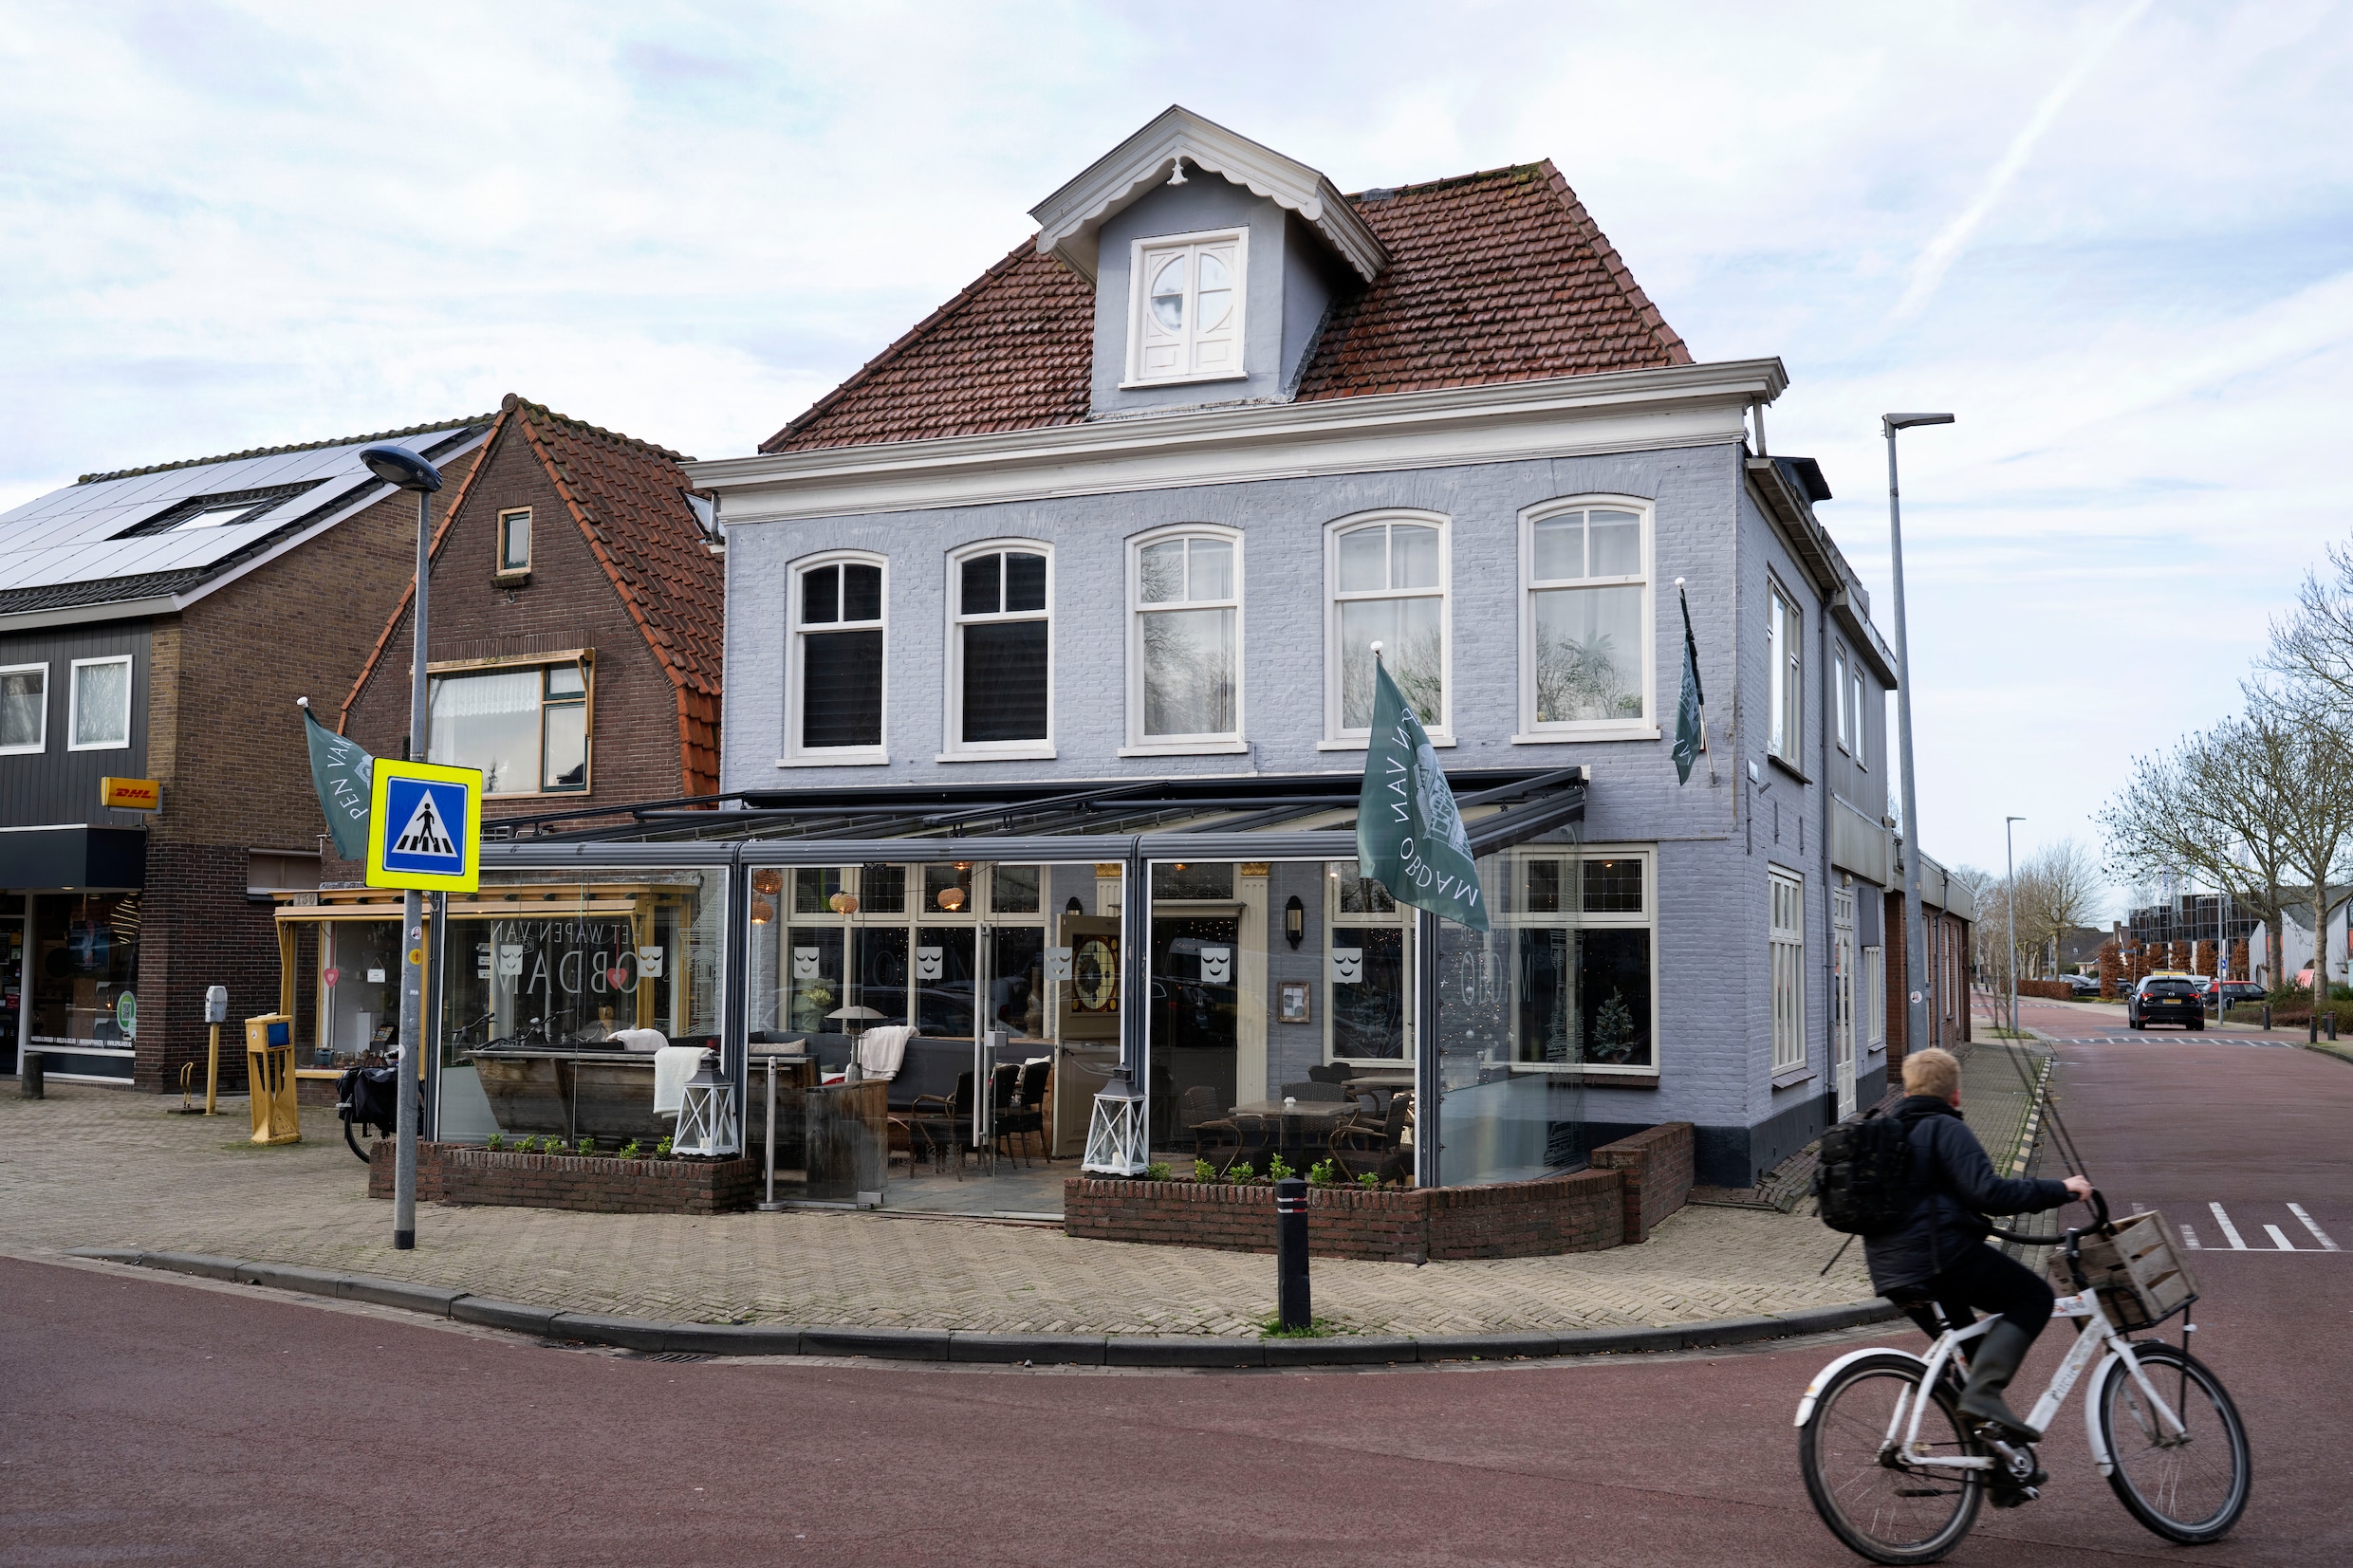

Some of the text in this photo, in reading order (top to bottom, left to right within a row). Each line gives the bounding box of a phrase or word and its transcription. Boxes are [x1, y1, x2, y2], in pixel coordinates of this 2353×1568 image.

[326, 736, 354, 768] VAN
[115, 787, 152, 800] DHL
[296, 894, 316, 905] 130
[1460, 950, 1531, 1006] OBDAM
